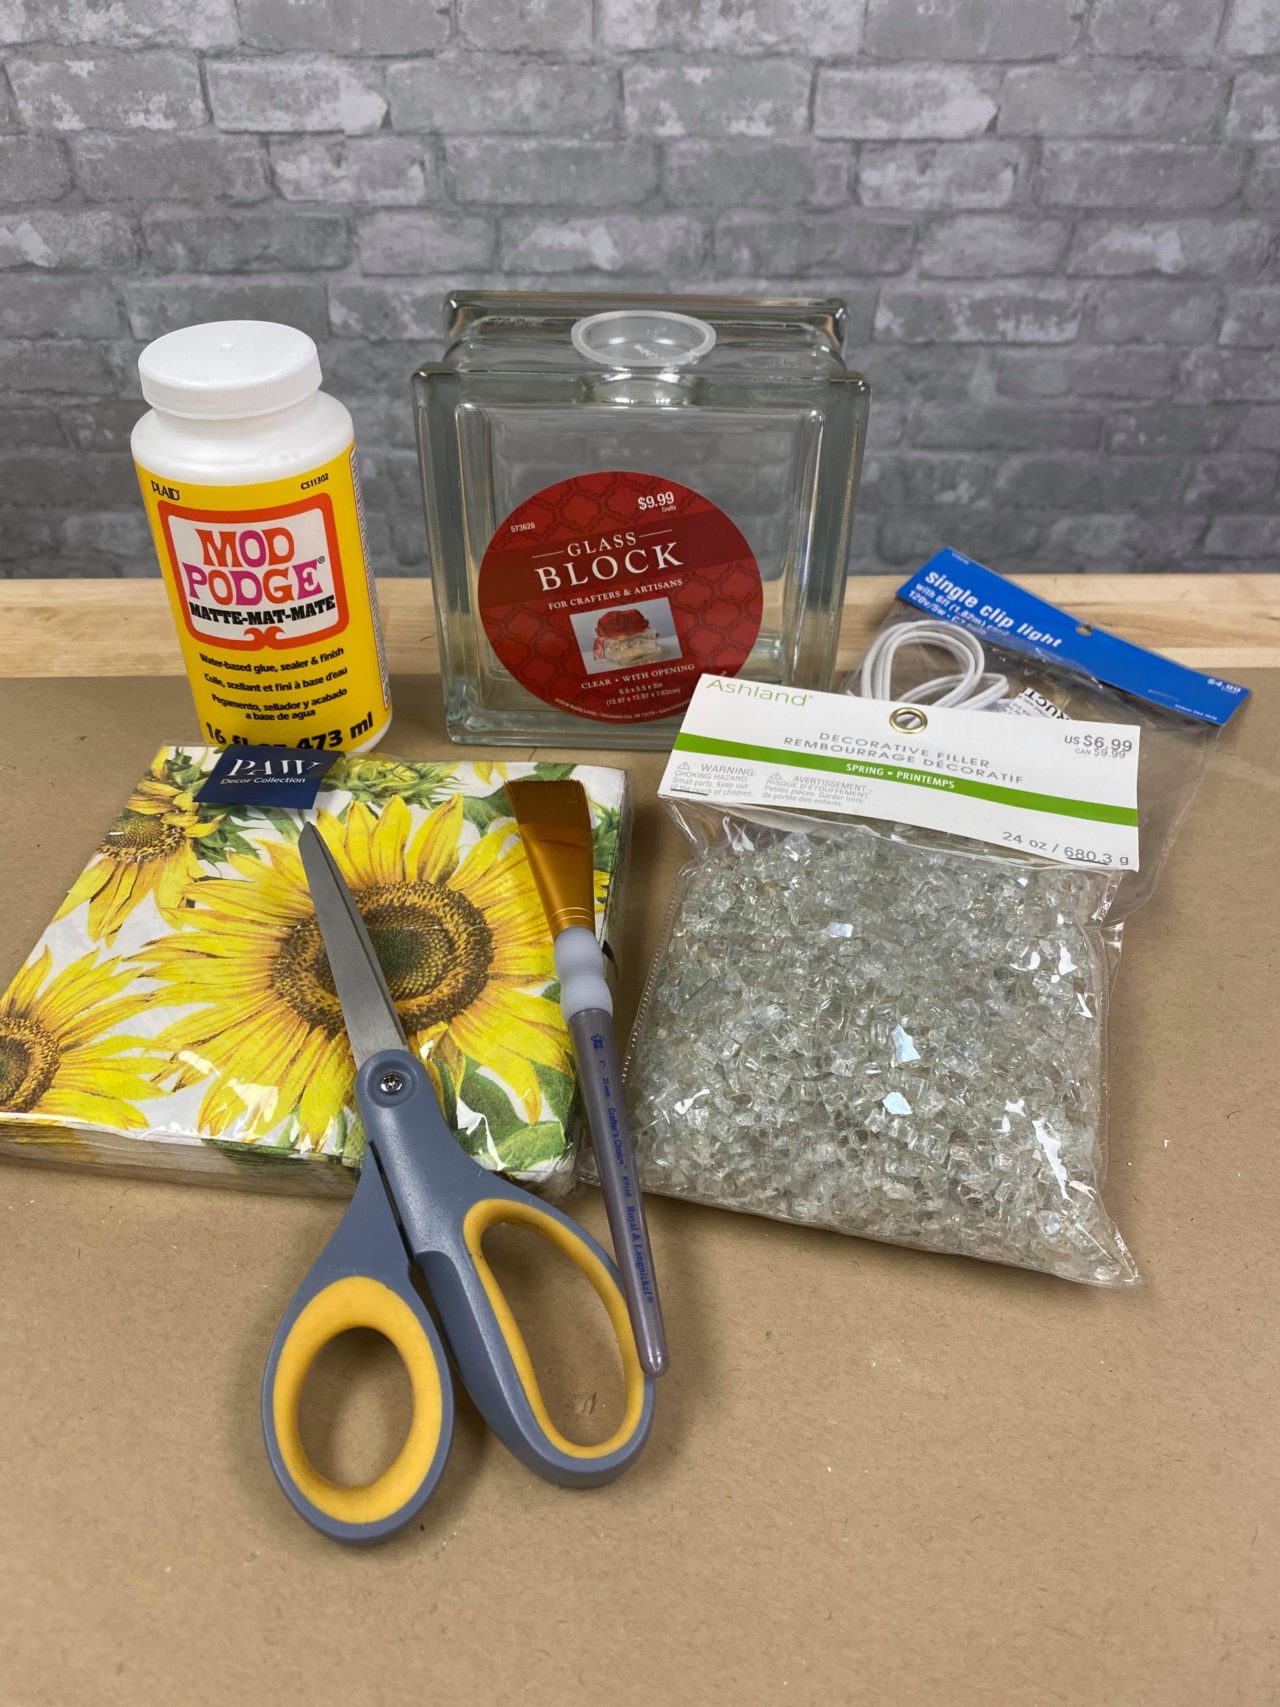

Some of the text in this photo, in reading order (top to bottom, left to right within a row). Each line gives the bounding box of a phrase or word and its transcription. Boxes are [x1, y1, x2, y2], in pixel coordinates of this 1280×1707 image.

[151, 480, 180, 501] PLAID
[301, 473, 329, 490] CS11302
[638, 491, 674, 511] $9.99
[510, 522, 536, 533] 573626
[194, 527, 295, 568] MOD
[567, 532, 637, 557] GLASS
[534, 542, 684, 592] BLOCK
[181, 558, 324, 606] PODGE
[548, 578, 683, 610] FOR CRAFTERS & ARTISANS
[915, 583, 936, 599] with
[935, 594, 951, 608] 6ft
[188, 595, 336, 625] MATTE-MAT-MATE
[924, 571, 1063, 648] single clip light
[199, 647, 344, 674] Water-based glue, sealer & finish
[204, 667, 348, 692] Colle, scellant et fini à base d'eau
[581, 663, 695, 690] CLEAR WITH OPENING
[212, 688, 347, 712] Pegamento, sellador y acabado
[706, 679, 807, 706] Ashland
[245, 712, 251, 720] a
[253, 712, 275, 721] base
[291, 709, 316, 721] agua
[206, 722, 227, 745] 16
[296, 729, 344, 751] 473
[349, 711, 374, 740] ml
[1064, 734, 1132, 752] US $6.99
[784, 737, 1024, 784] REMBOURRAGE DÉCORATIF
[819, 732, 990, 768] DECORATIVE FILLER
[1074, 747, 1126, 759] CAN $9.99
[227, 759, 323, 777] PAW
[674, 770, 748, 782] CHOKING HAZARD
[846, 763, 955, 789] SPRING PRINTEMPS
[253, 777, 306, 785] Collection
[672, 776, 693, 785] Small
[716, 781, 734, 789] Keep
[764, 785, 789, 794] Petites
[766, 779, 798, 789] RISQUE
[1002, 831, 1023, 844] 24
[1029, 839, 1047, 851] oz
[1064, 846, 1113, 864] 680.3
[1119, 856, 1129, 865] g
[608, 1107, 620, 1138] Crafter's
[614, 1139, 625, 1166] Choice
[626, 1205, 639, 1231] Royal
[632, 1233, 641, 1241] &
[634, 1243, 653, 1295] Langnickel
